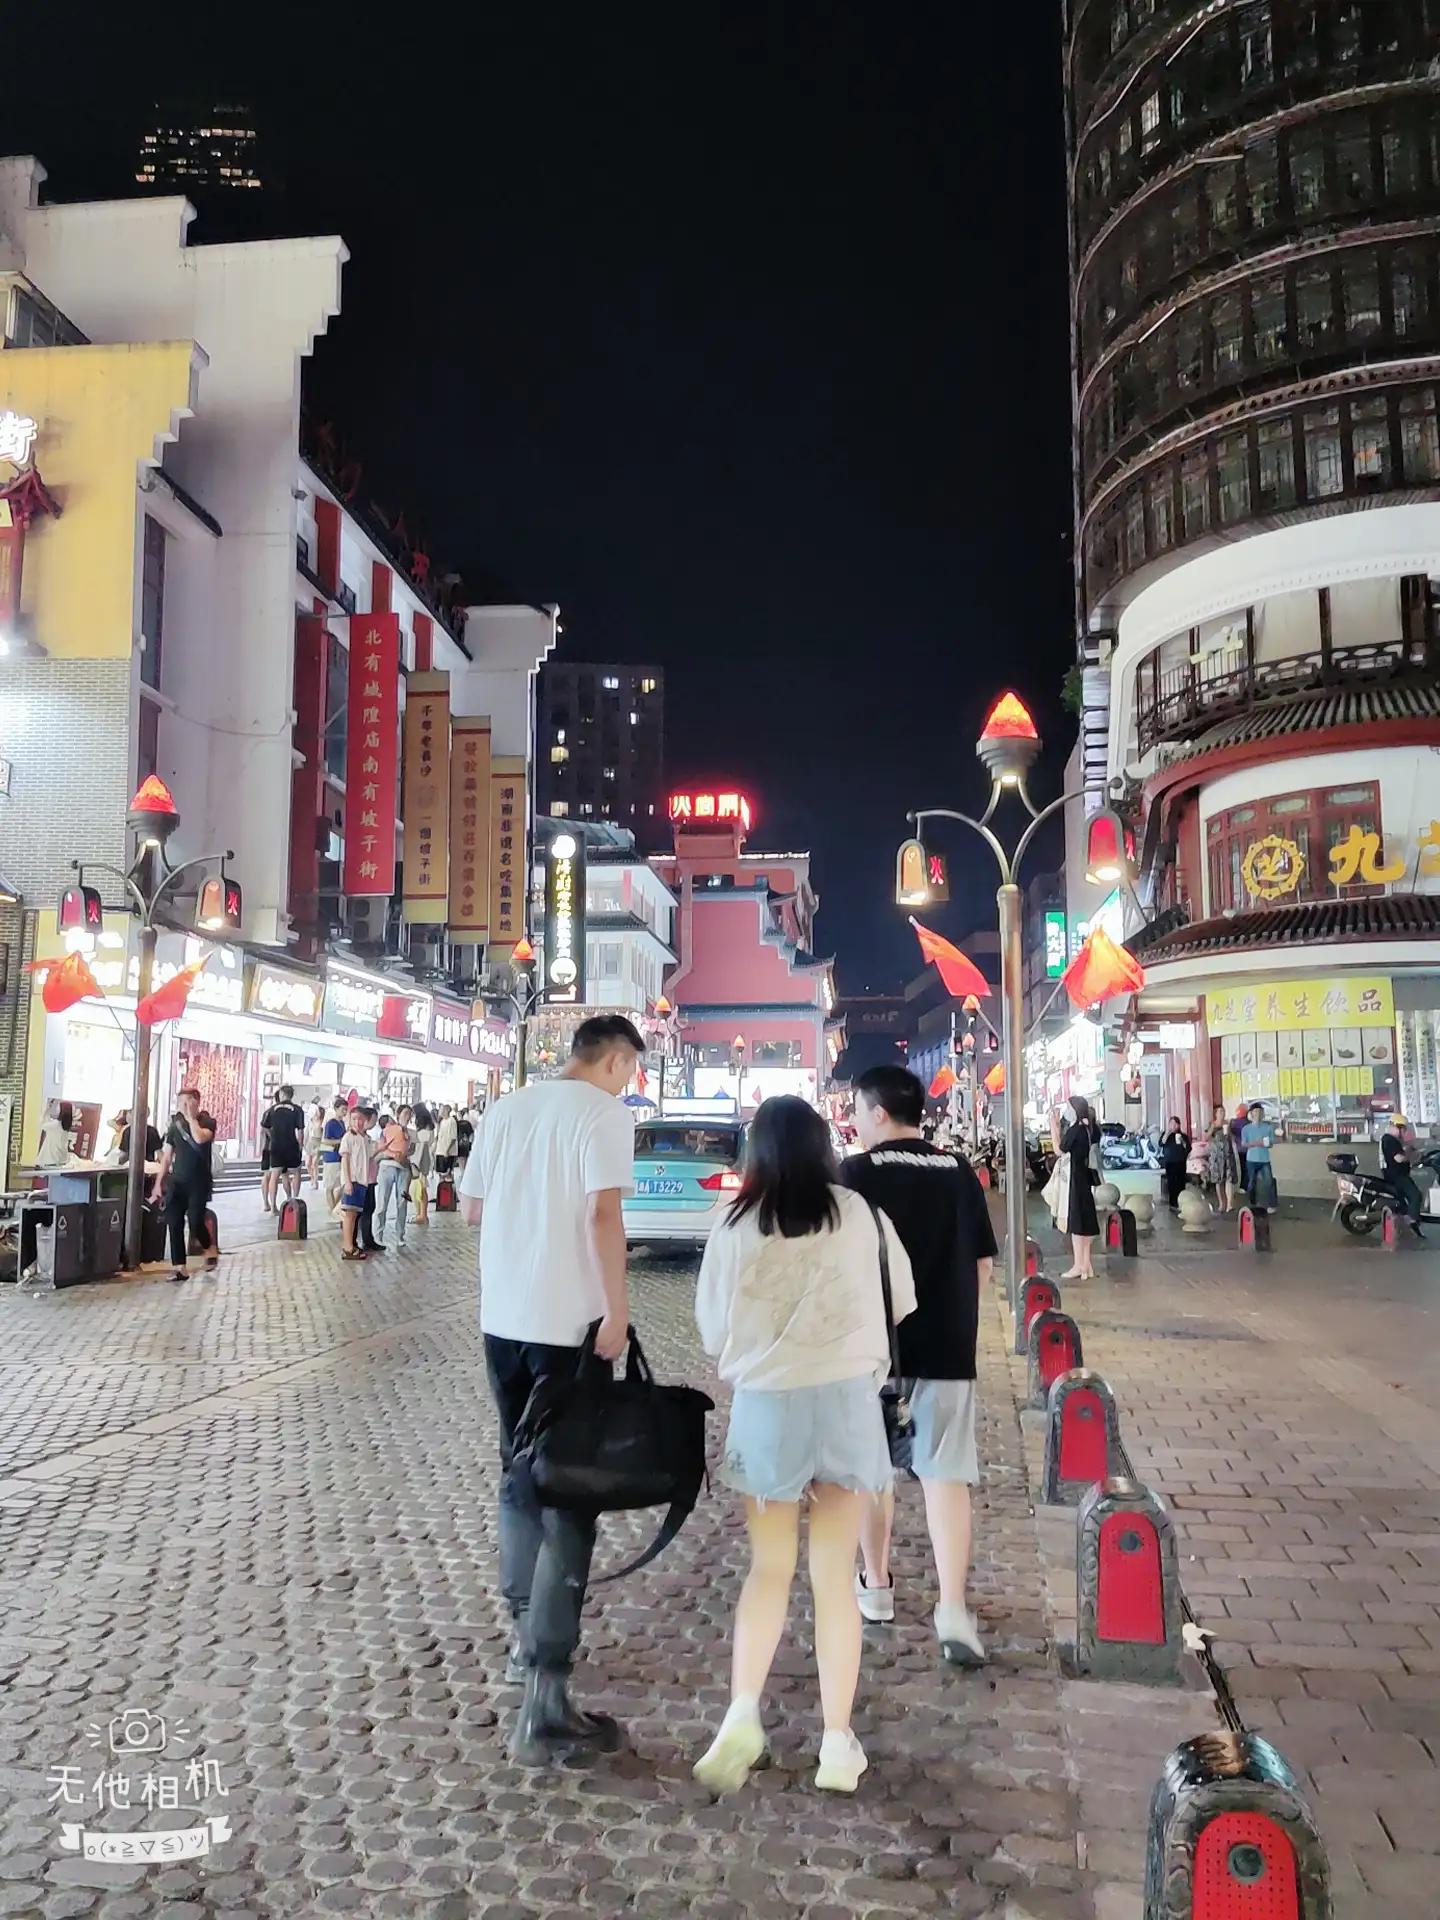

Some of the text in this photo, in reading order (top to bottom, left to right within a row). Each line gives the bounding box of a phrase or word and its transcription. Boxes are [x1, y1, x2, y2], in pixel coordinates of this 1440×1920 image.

[359, 629, 383, 880] 北有城隍庙南有坡子街
